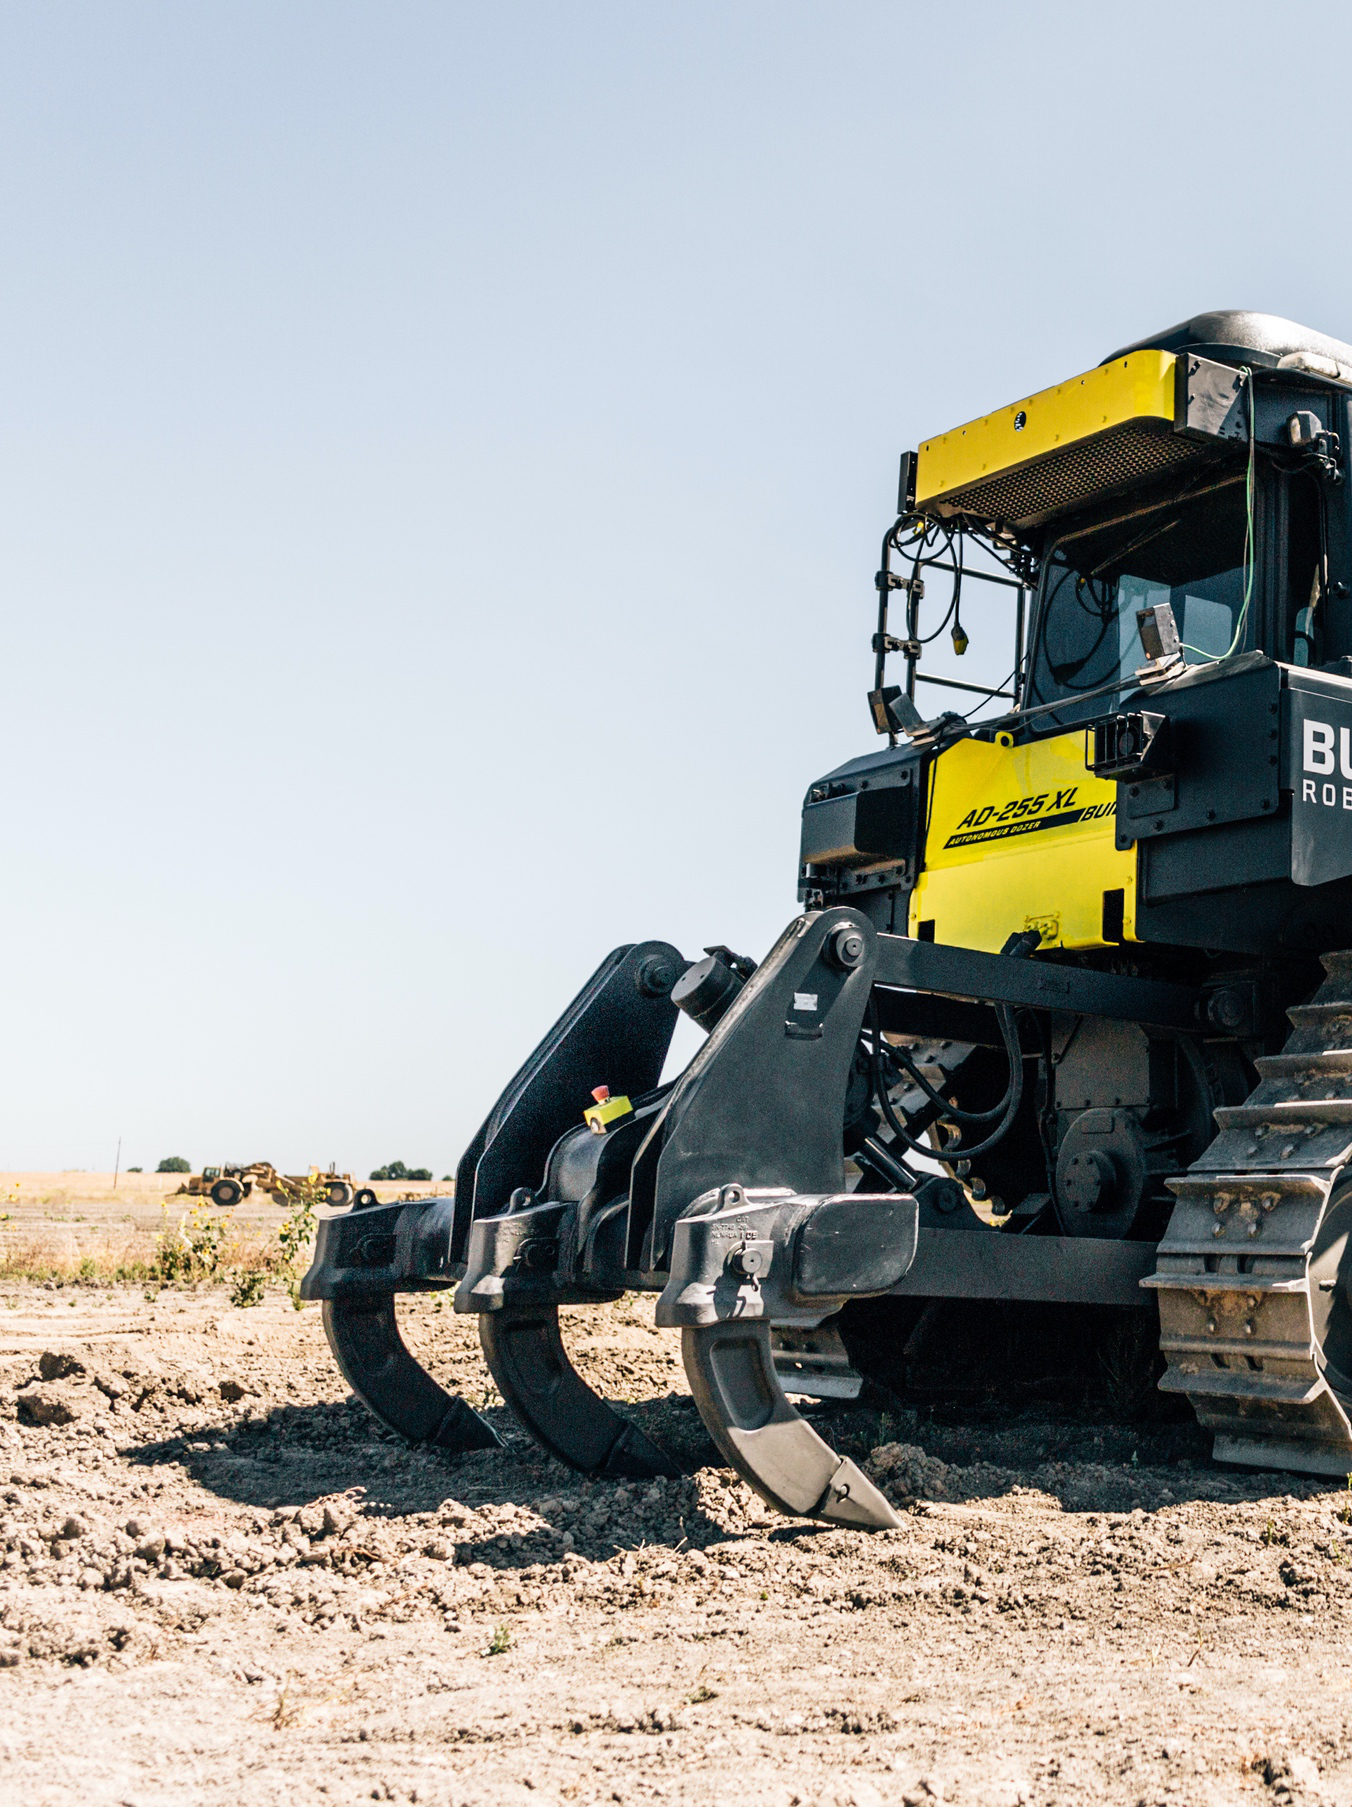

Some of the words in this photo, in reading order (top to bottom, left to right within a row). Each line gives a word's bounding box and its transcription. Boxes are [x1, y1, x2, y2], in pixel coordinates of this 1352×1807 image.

[956, 793, 1049, 830] AD-255
[1046, 787, 1079, 812] XL
[948, 828, 1009, 846] AUTONOMOUS
[1010, 820, 1042, 834] DOZER
